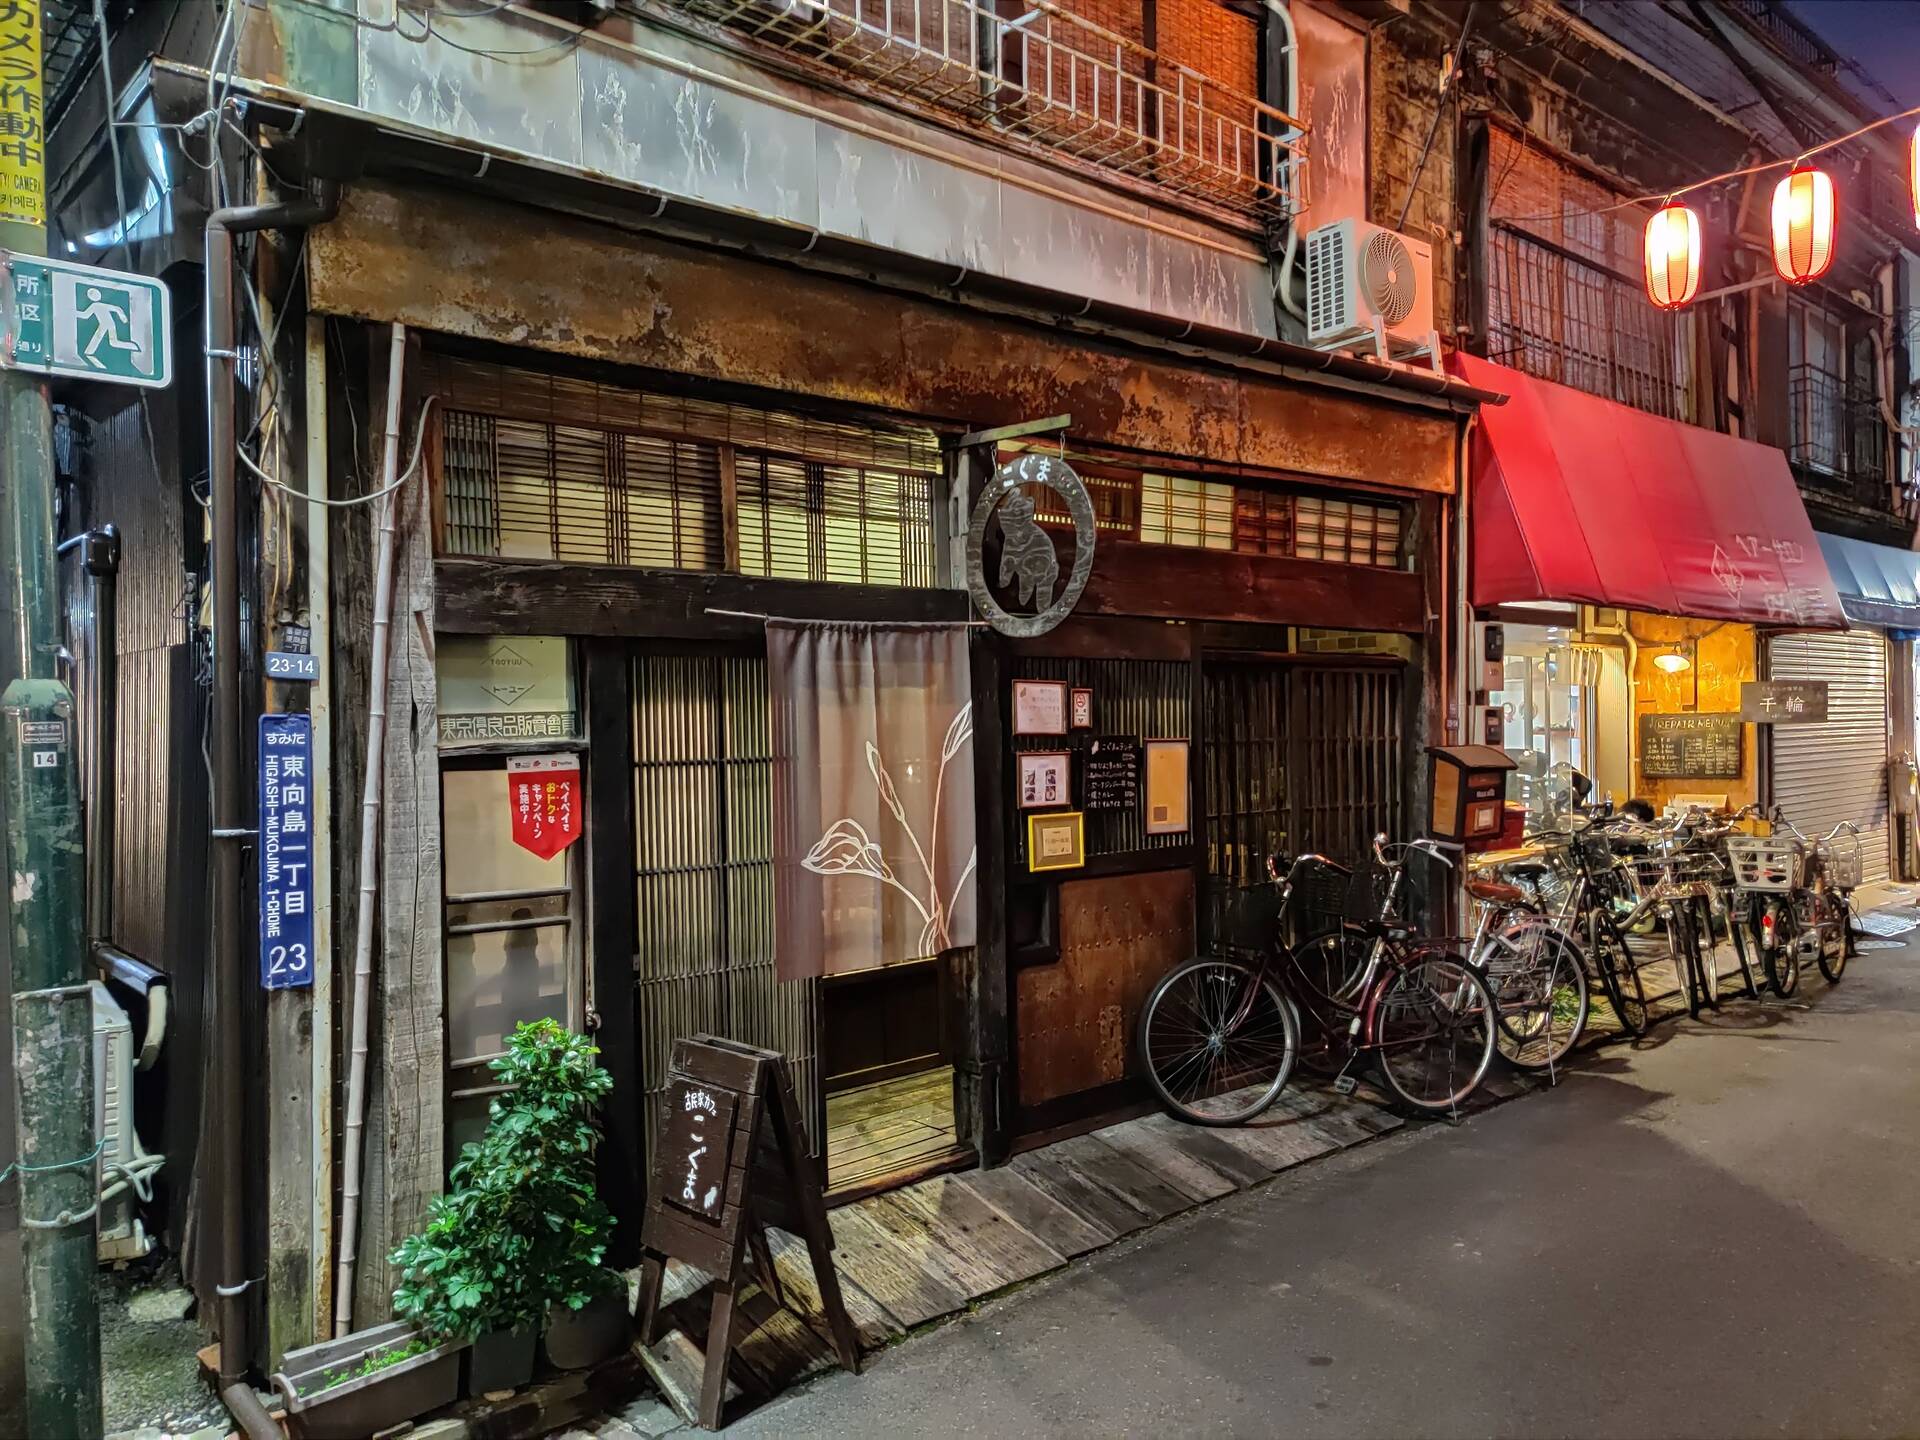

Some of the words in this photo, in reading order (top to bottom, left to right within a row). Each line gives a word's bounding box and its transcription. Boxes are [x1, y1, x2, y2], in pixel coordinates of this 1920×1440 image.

[17, 274, 39, 296] 所
[1003, 454, 1051, 486] こぐま
[270, 658, 314, 673] 23-14
[1760, 696, 1805, 713] 千輪
[1657, 719, 1695, 729] REPAIR
[36, 754, 55, 765] 14
[265, 754, 280, 883] HIGASHI-MUKOJIMA
[532, 784, 542, 839] キャンペーン
[546, 782, 556, 824] おトクな
[560, 782, 570, 832] ペイペイで
[282, 755, 307, 915] 東向島一丁目
[267, 888, 280, 938] 1-CHOME
[269, 943, 306, 974] 23
[683, 1114, 706, 1200] こぐま
